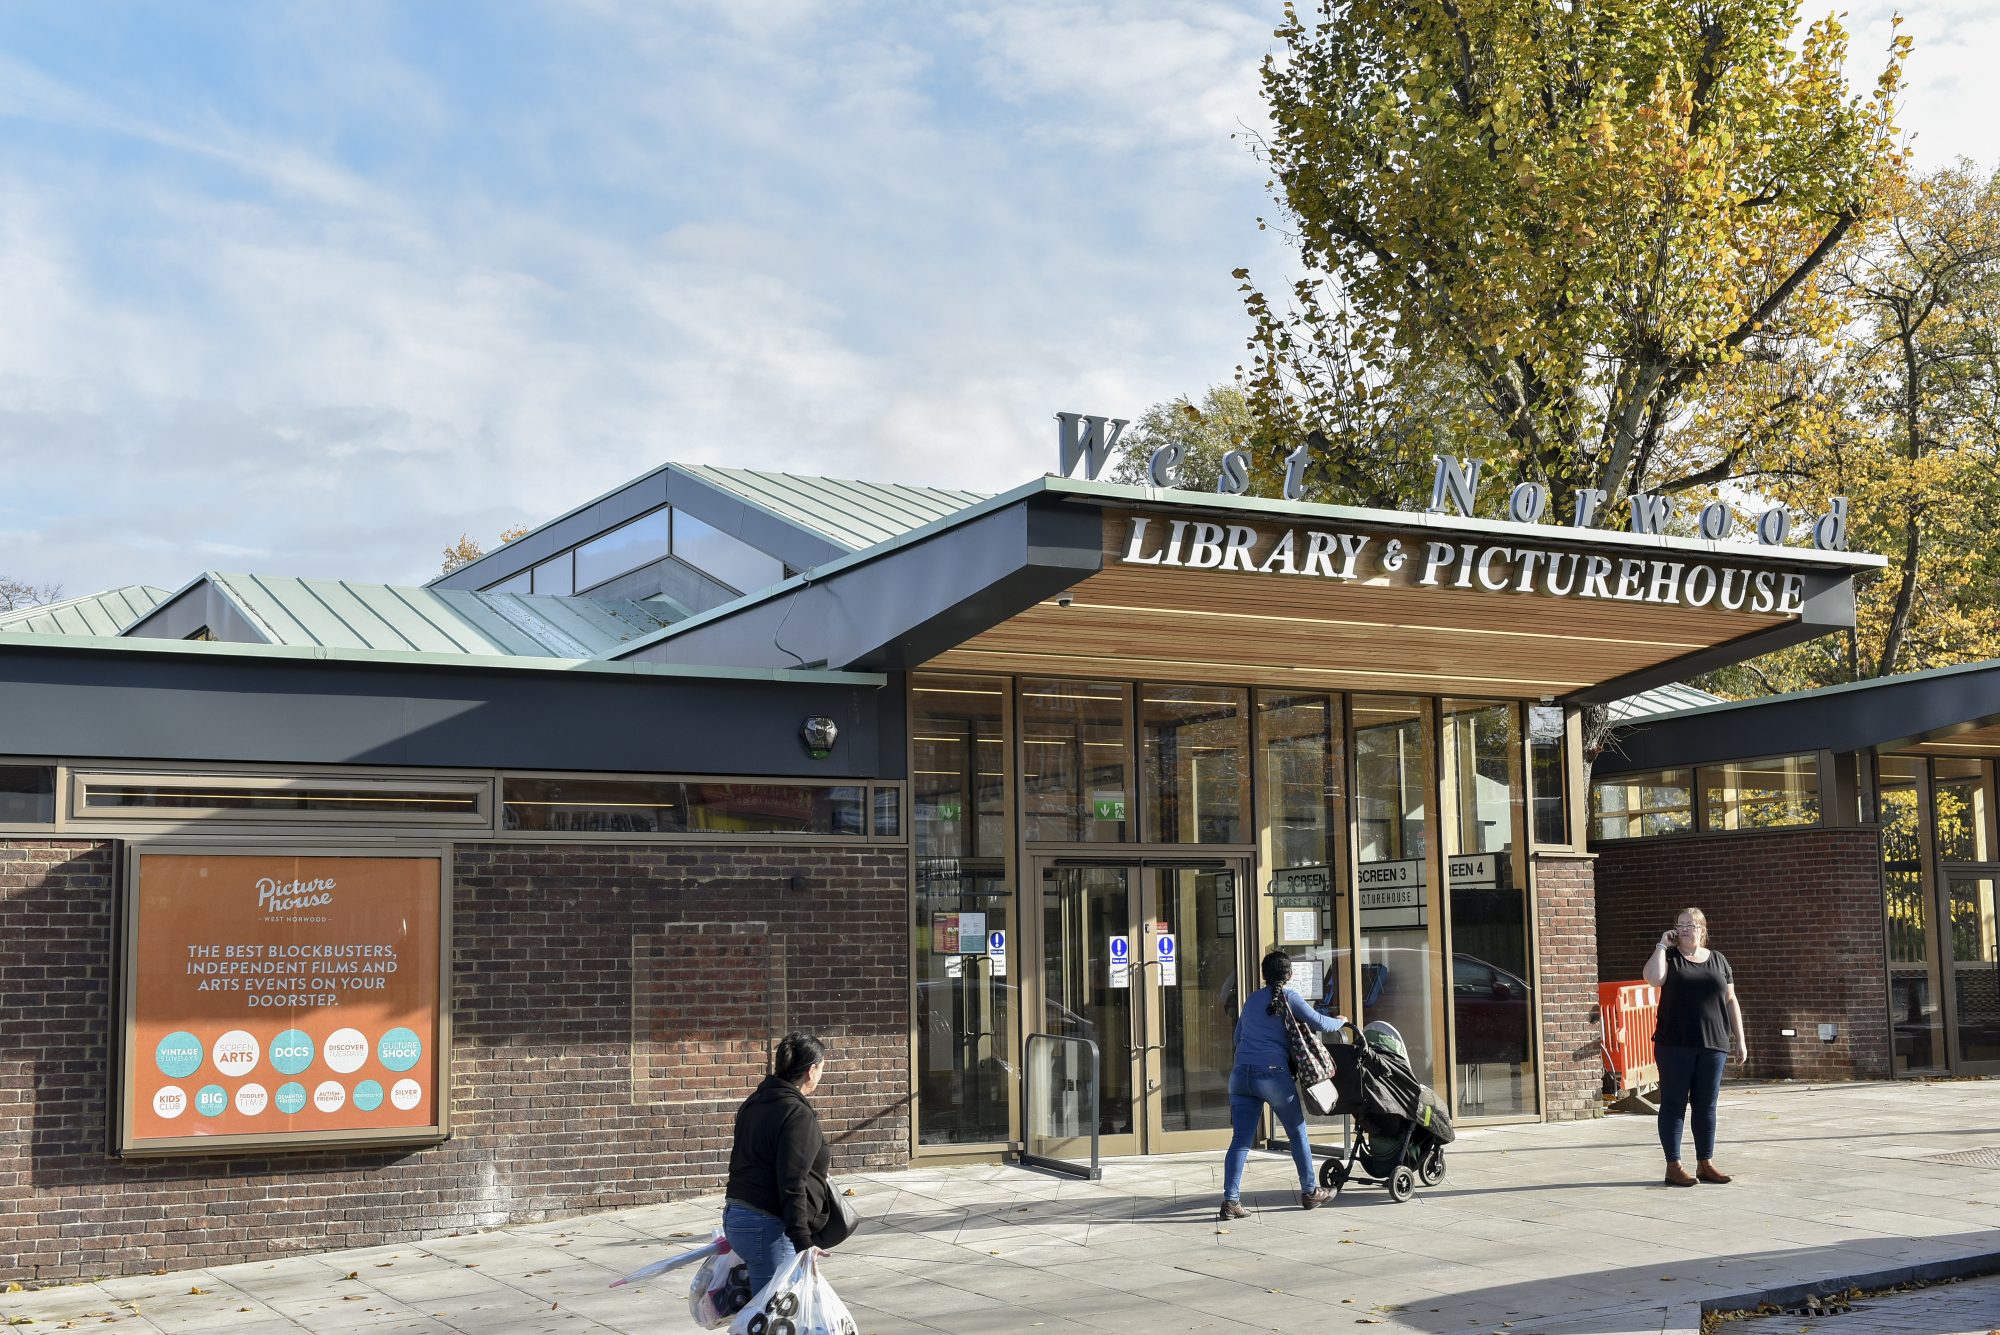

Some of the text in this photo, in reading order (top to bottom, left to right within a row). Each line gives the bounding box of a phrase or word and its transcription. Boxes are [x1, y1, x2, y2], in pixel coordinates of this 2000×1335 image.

[1052, 411, 1848, 551] West Norwood
[1122, 517, 1807, 615] LIBRARY & PICTUREHOUSE
[1358, 867, 1407, 884] SCREEN 3
[1476, 861, 1484, 876] 4
[1287, 873, 1326, 888] SCREEN
[255, 877, 336, 907] Picture
[1361, 891, 1412, 905] CTUREHOUSE
[268, 893, 333, 913] house
[187, 944, 397, 960] THE BEST BLOCKBUSTERS,
[186, 961, 398, 975] INDEPENDENT FILMS AND
[197, 977, 386, 991] ARTS EVENTS ON YOUR
[247, 994, 339, 1007] DOORSTEP.
[160, 1048, 199, 1056] VINTAGE
[219, 1044, 254, 1052] SCREEN
[274, 1047, 309, 1058] DOCS
[382, 1041, 418, 1050] CULTURE
[219, 1052, 254, 1063] ARTS
[382, 1049, 417, 1058] SHOCK
[201, 1092, 223, 1104] BIG
[240, 1098, 265, 1107] TIME
[159, 1102, 181, 1111] CLUB
